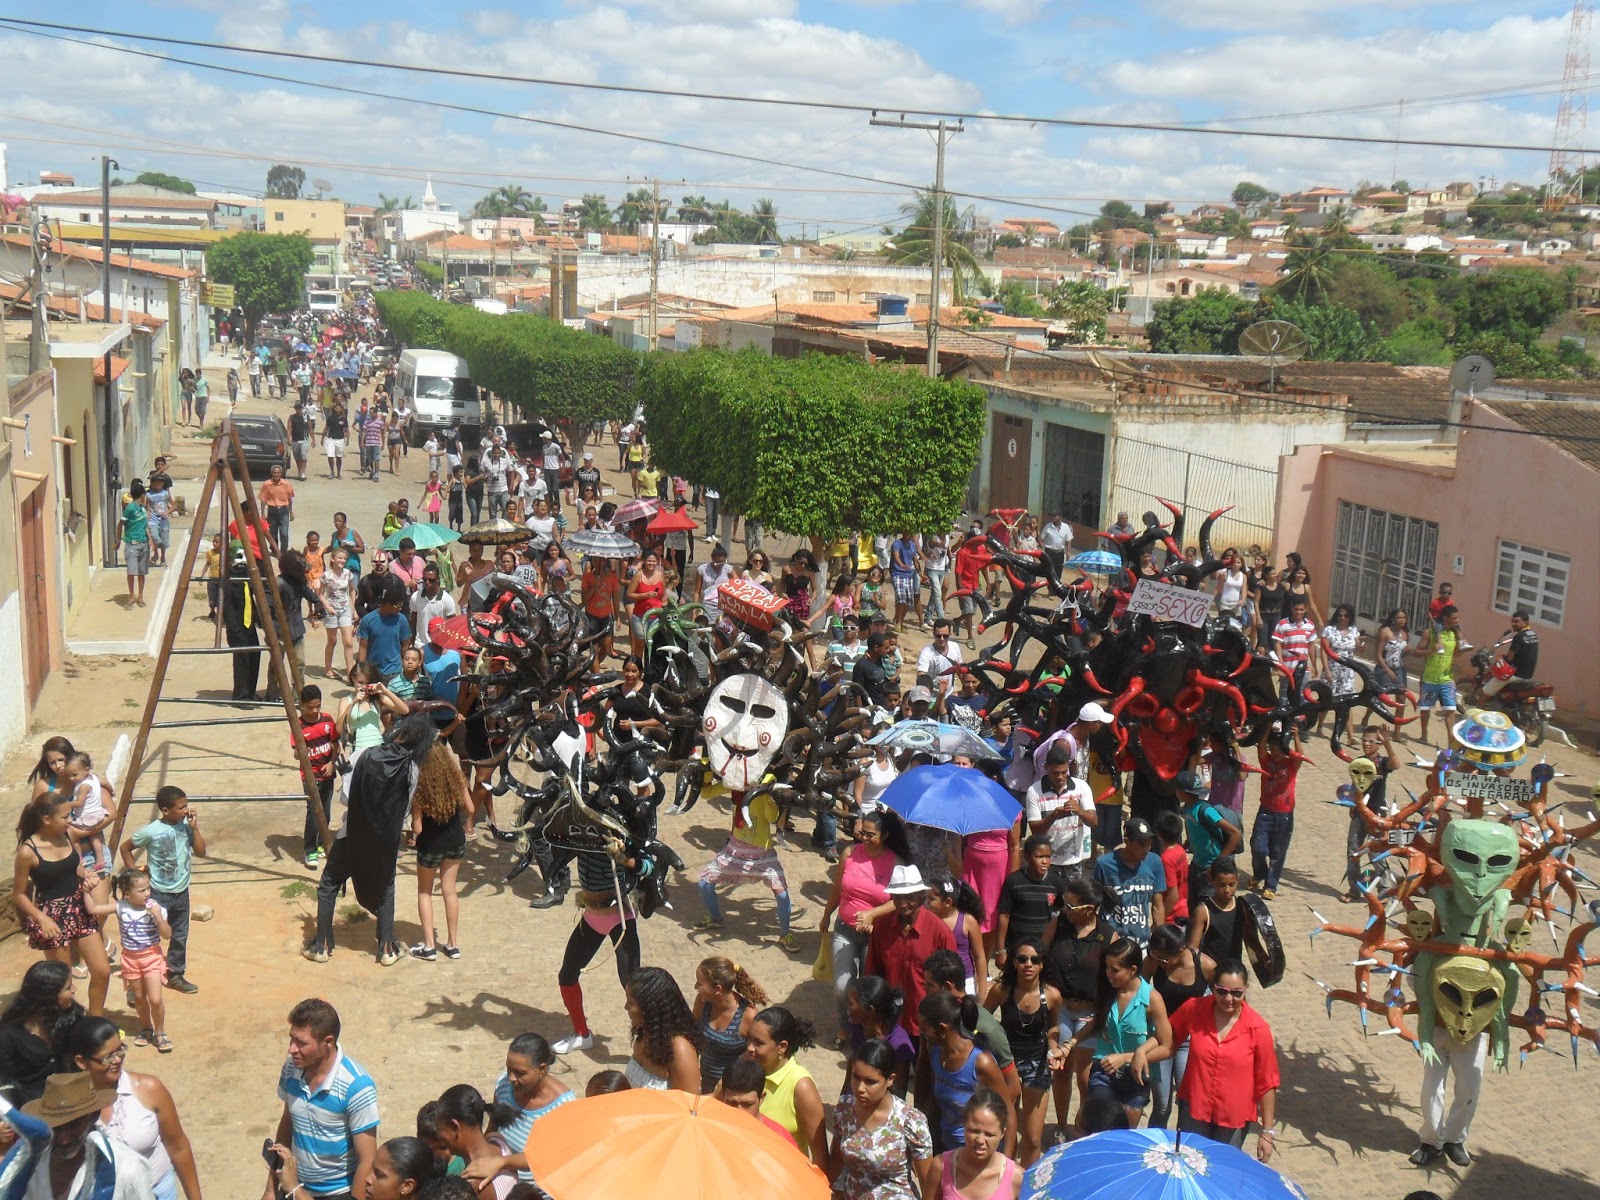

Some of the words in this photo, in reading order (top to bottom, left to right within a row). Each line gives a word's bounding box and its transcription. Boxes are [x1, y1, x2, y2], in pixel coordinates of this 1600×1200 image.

[1468, 365, 1481, 373] 21
[1138, 580, 1209, 605] PROFESSOR
[1155, 595, 1208, 623] SEXO
[1446, 779, 1462, 788] OS
[1467, 781, 1536, 794] INVASORES
[1462, 773, 1478, 782] HA
[1484, 775, 1501, 784] HA
[1509, 778, 1527, 786] HA
